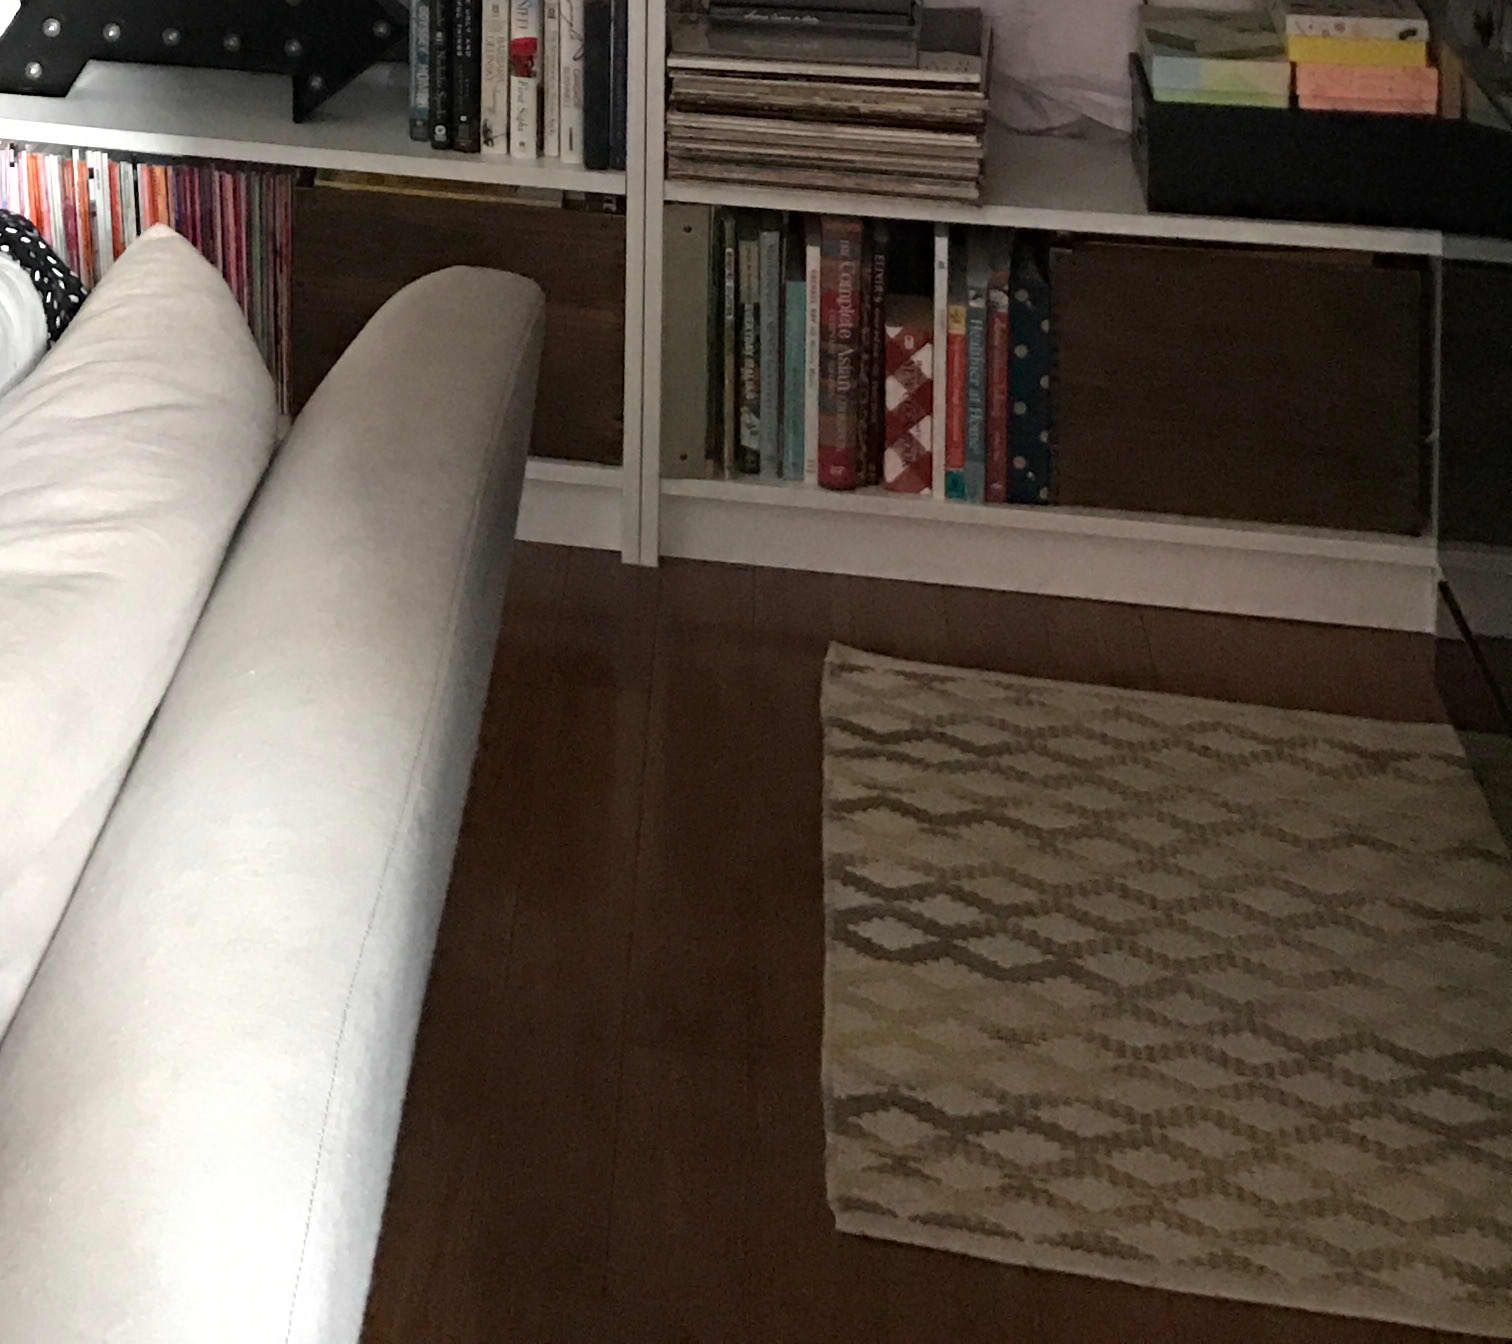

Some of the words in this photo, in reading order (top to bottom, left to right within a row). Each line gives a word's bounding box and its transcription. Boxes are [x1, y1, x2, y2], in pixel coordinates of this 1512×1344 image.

[463, 37, 472, 58] AND
[834, 260, 858, 340] Complete
[743, 303, 755, 357] EVERYDAY
[969, 318, 984, 386] Healthier
[835, 346, 856, 393] Asian
[969, 387, 982, 403] at
[969, 406, 984, 449] Home
